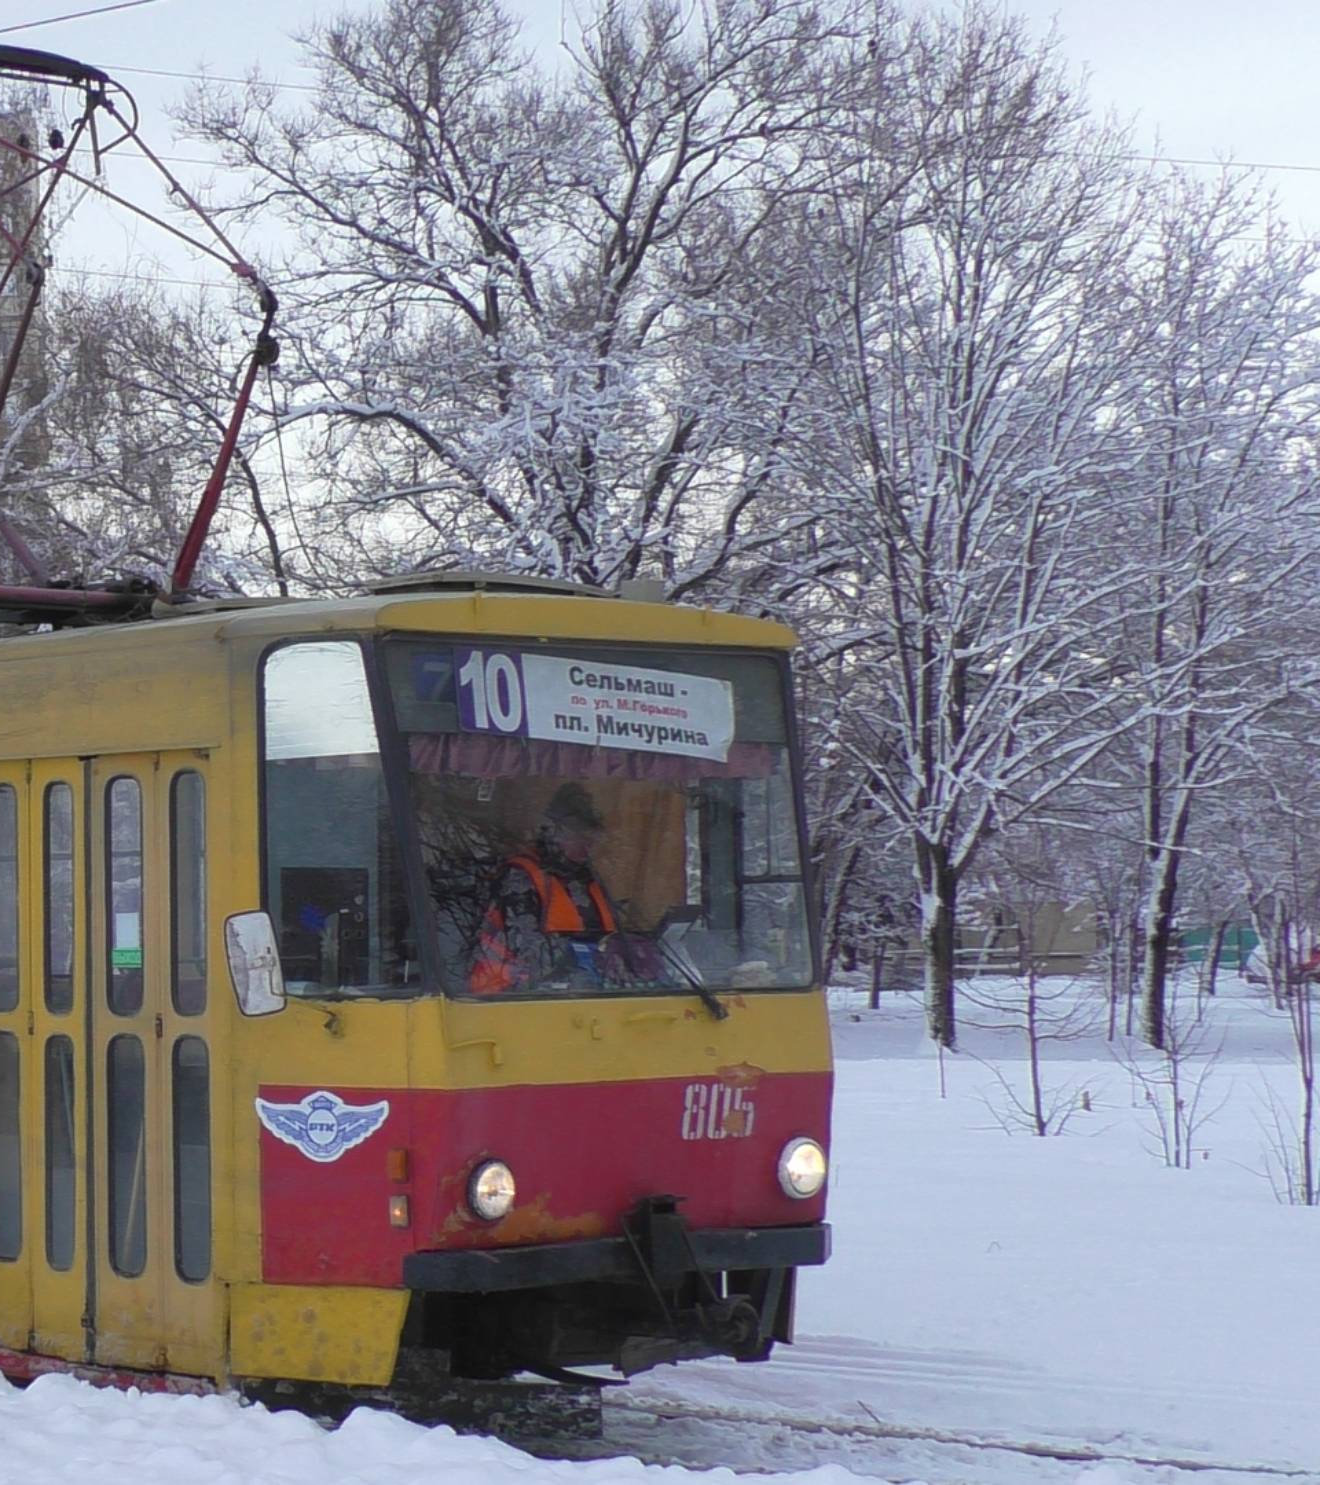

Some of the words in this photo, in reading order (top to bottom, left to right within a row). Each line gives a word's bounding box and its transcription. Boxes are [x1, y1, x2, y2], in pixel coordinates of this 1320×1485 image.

[459, 650, 522, 732] 10
[569, 666, 675, 698] Сельмаш
[571, 695, 587, 706] по
[594, 698, 613, 710] ул.
[554, 713, 589, 732] пл.
[596, 714, 710, 746] Мичурина
[681, 1083, 756, 1140] 805
